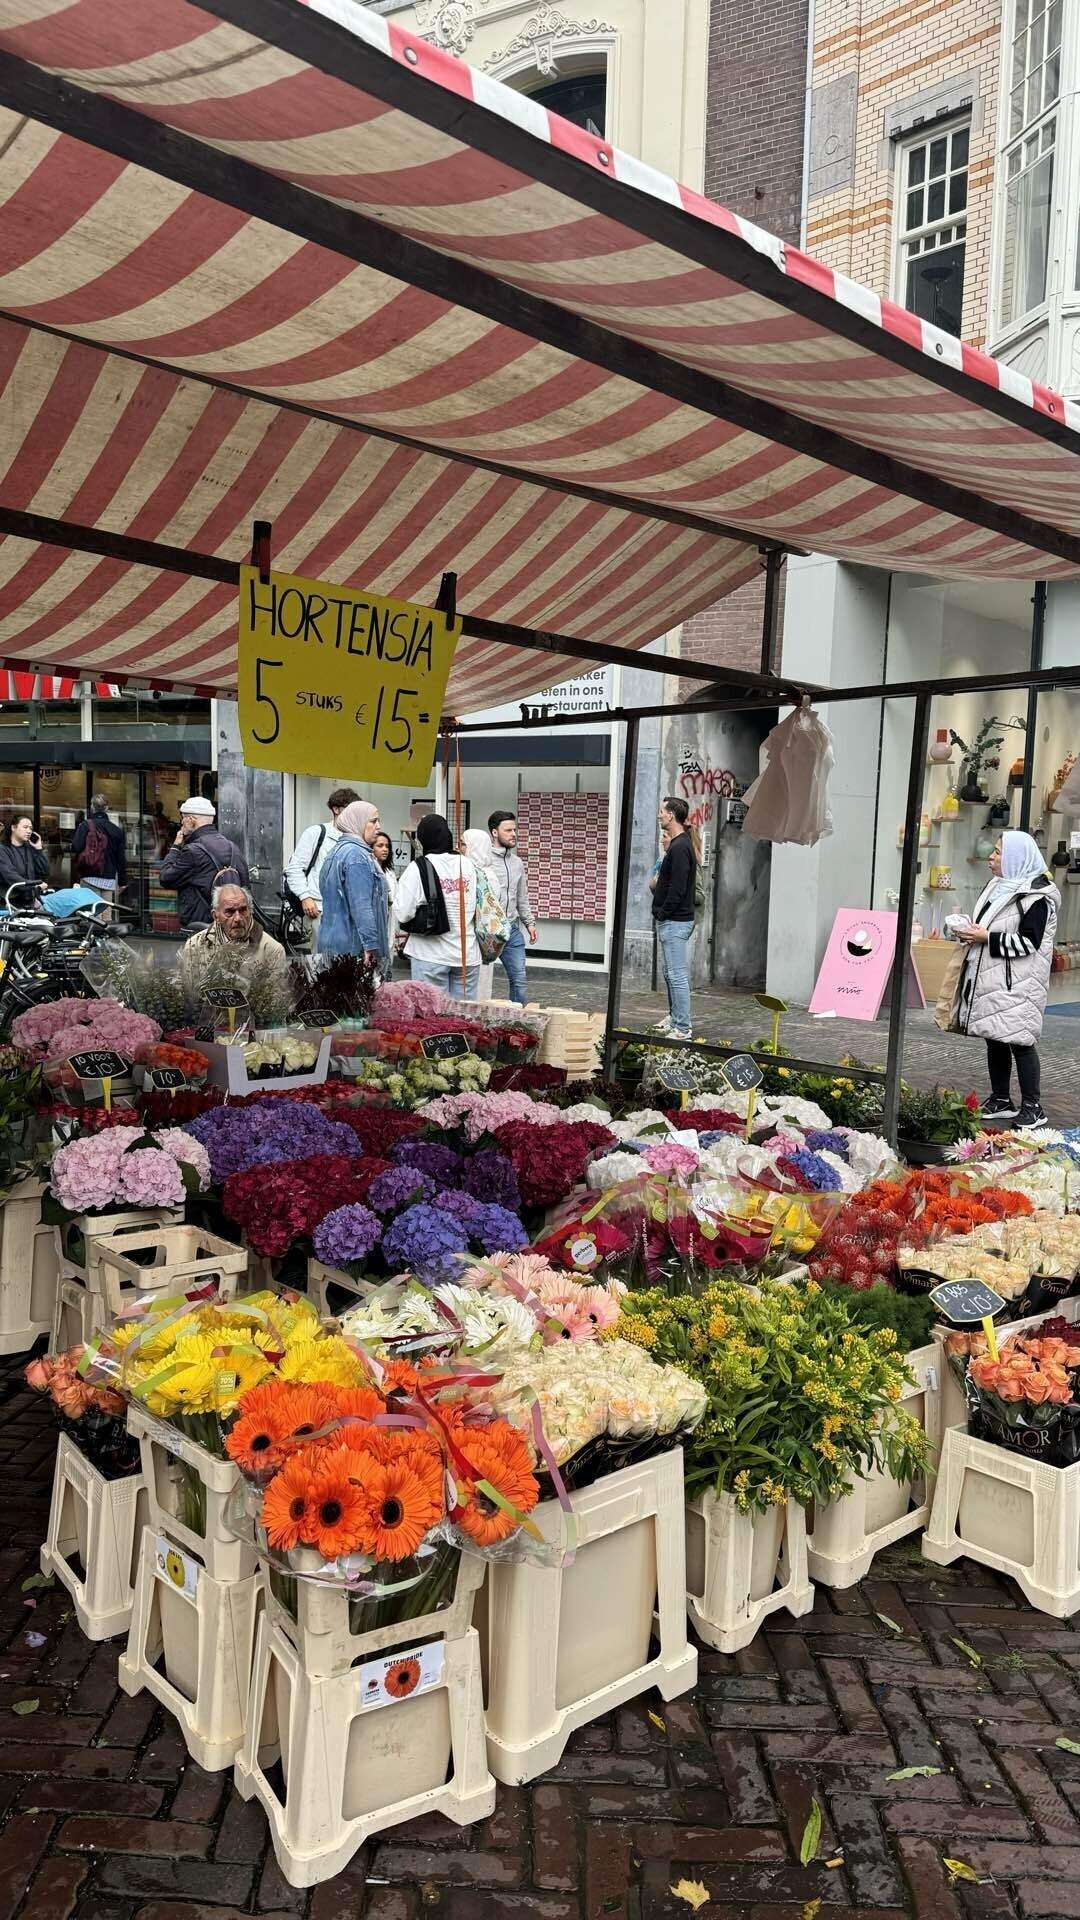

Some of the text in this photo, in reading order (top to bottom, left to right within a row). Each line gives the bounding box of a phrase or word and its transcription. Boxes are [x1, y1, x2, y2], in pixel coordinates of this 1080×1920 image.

[570, 684, 580, 696] in
[583, 686, 604, 696] ons
[252, 658, 284, 744] 5
[425, 1039, 434, 1048] 10
[75, 1052, 113, 1066] 10 VOOR
[936, 1291, 950, 1303] 2
[998, 1424, 1051, 1448] AMOR
[383, 1651, 424, 1669] DUTCH PRIDE
